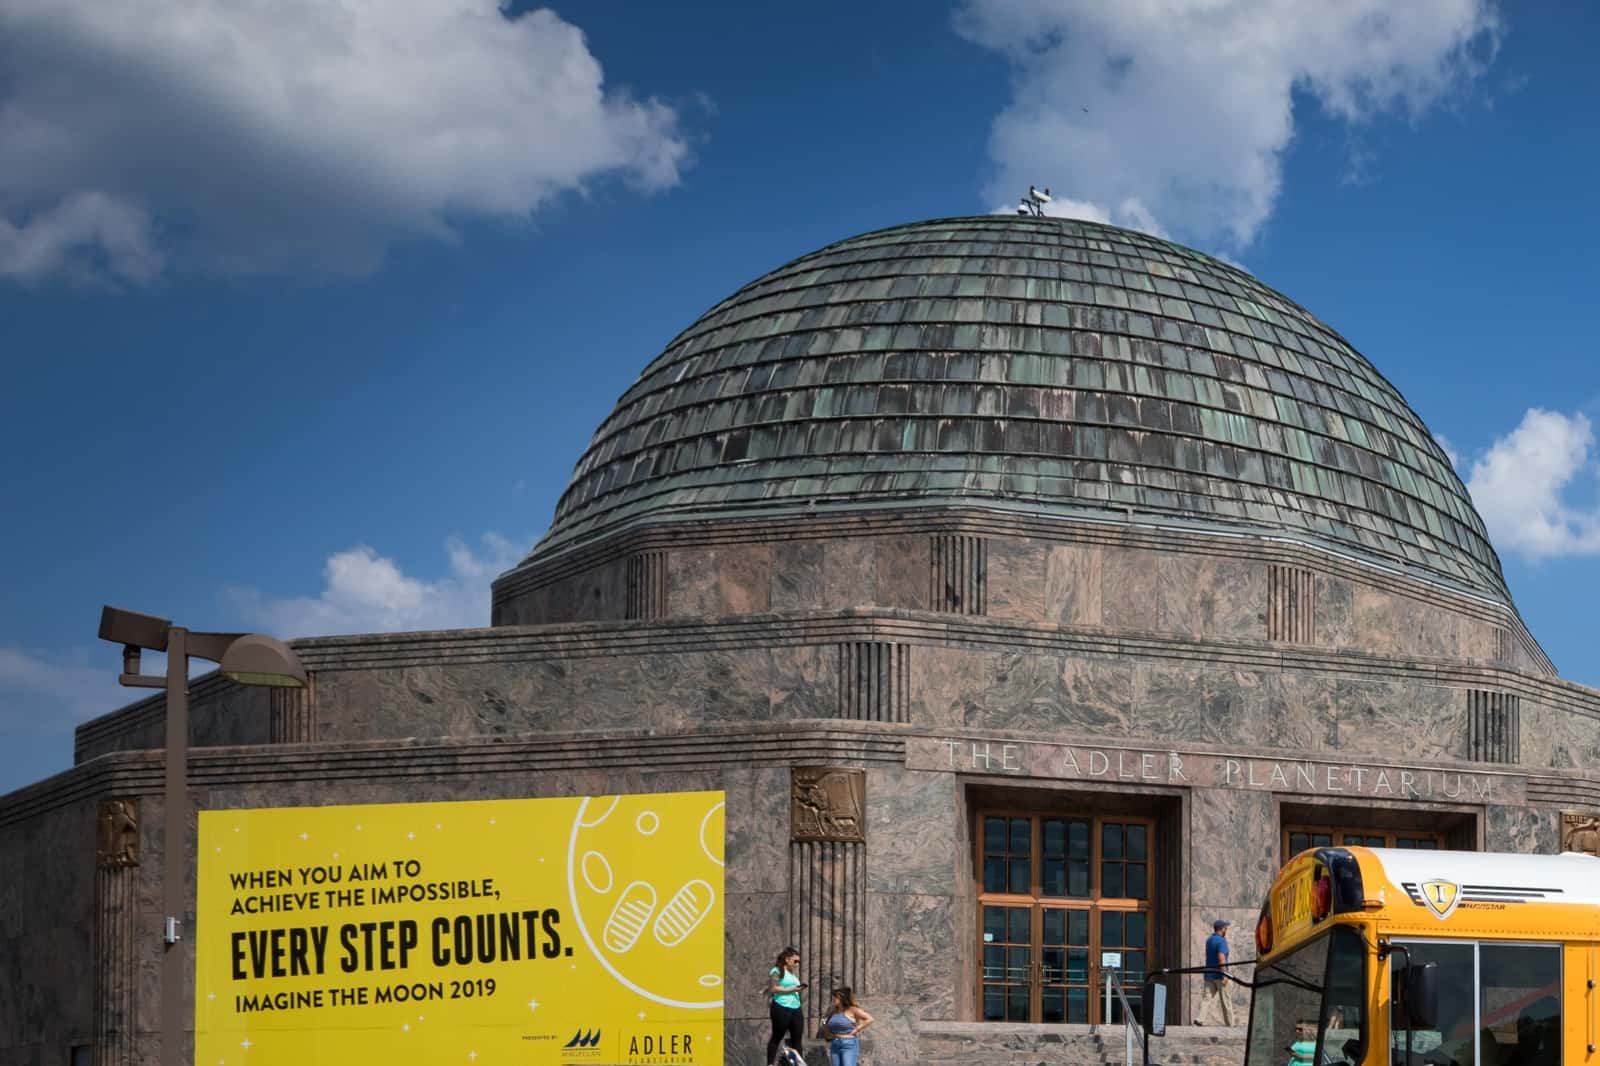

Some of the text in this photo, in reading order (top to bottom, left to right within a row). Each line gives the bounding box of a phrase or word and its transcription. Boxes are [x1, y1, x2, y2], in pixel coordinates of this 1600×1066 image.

[941, 738, 1492, 800] THE ADLER PLANETARIUM
[230, 859, 421, 890] WHEN YOU AIM TO
[231, 878, 500, 915] ACHIEVE THE IMPOSSIBLE,
[231, 908, 573, 980] EVERY STEP COUNTS.
[235, 978, 497, 1013] IMAGINE THE MOON 2019
[628, 1034, 693, 1056] ADLER
